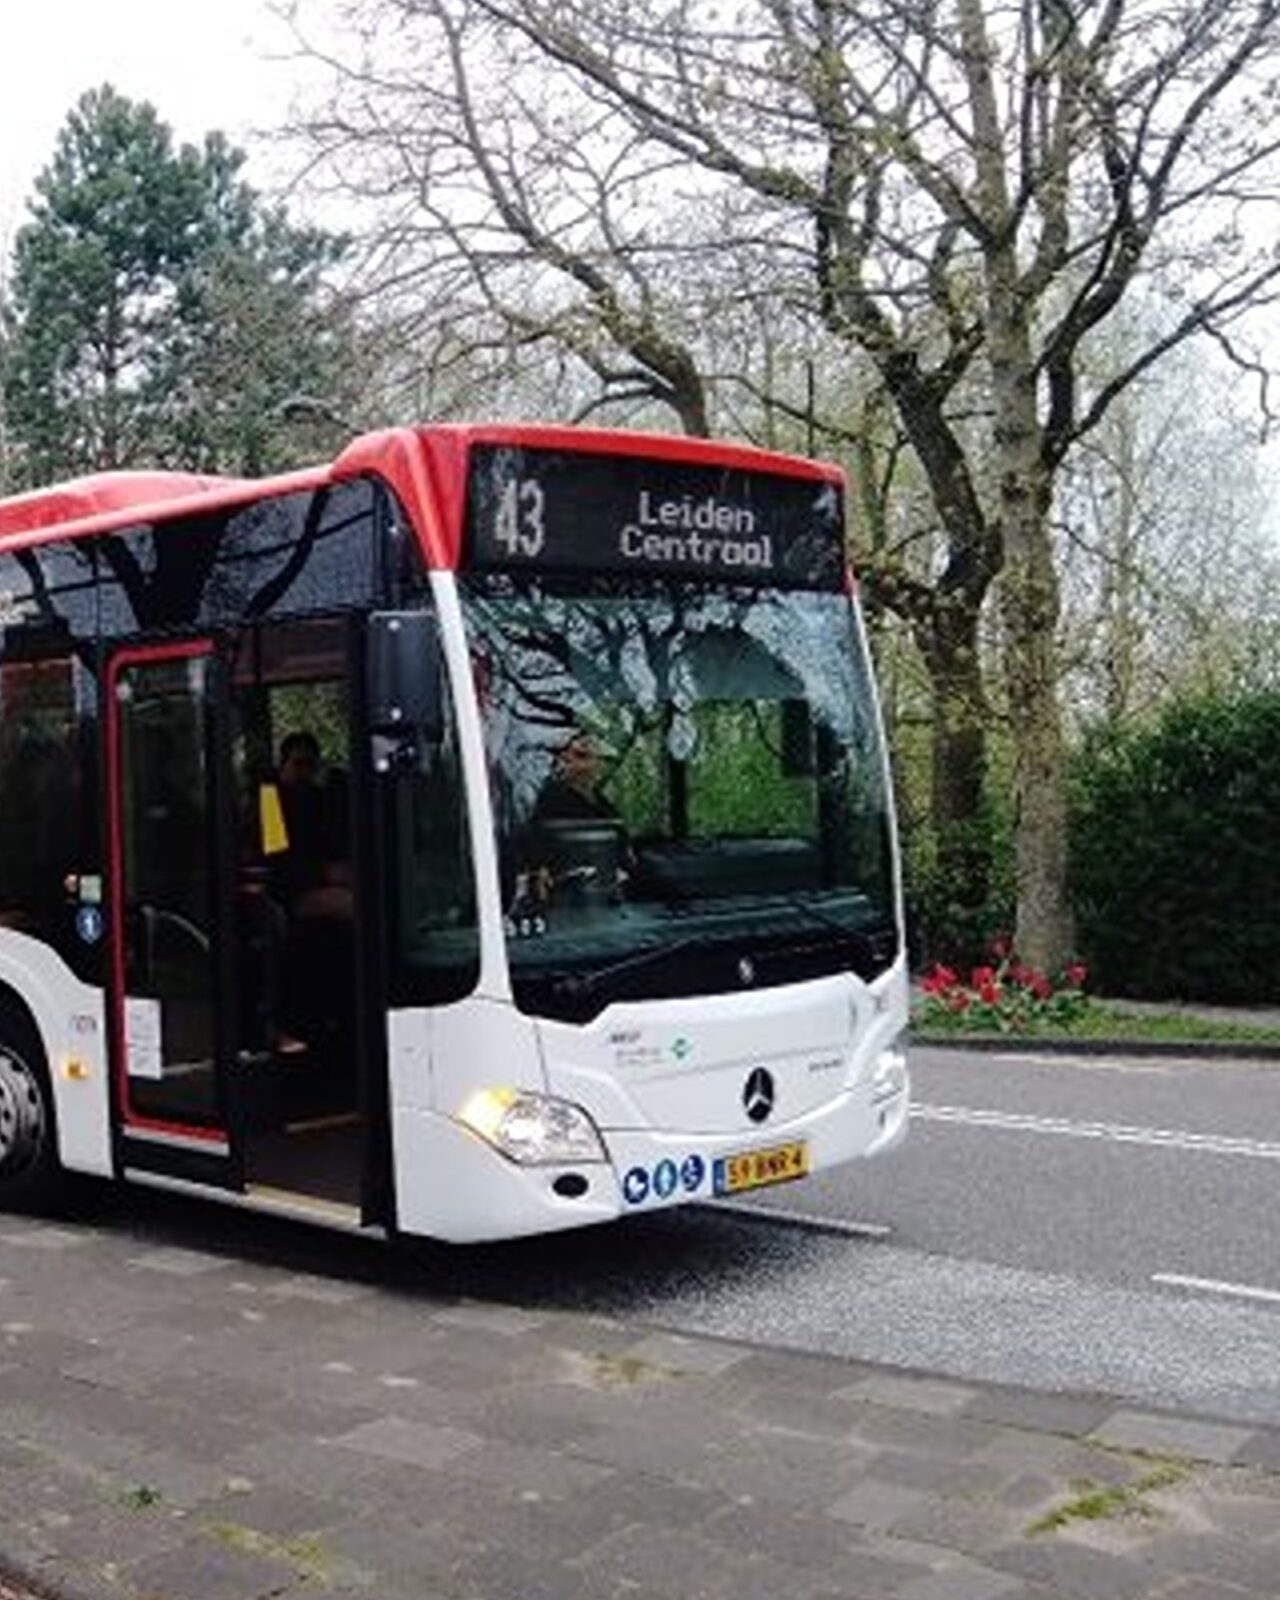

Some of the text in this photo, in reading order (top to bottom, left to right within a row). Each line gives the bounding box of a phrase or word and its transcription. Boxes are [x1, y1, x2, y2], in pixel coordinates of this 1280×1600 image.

[496, 480, 544, 557] 43
[639, 491, 755, 533] Leiden
[620, 525, 774, 568] Centraal
